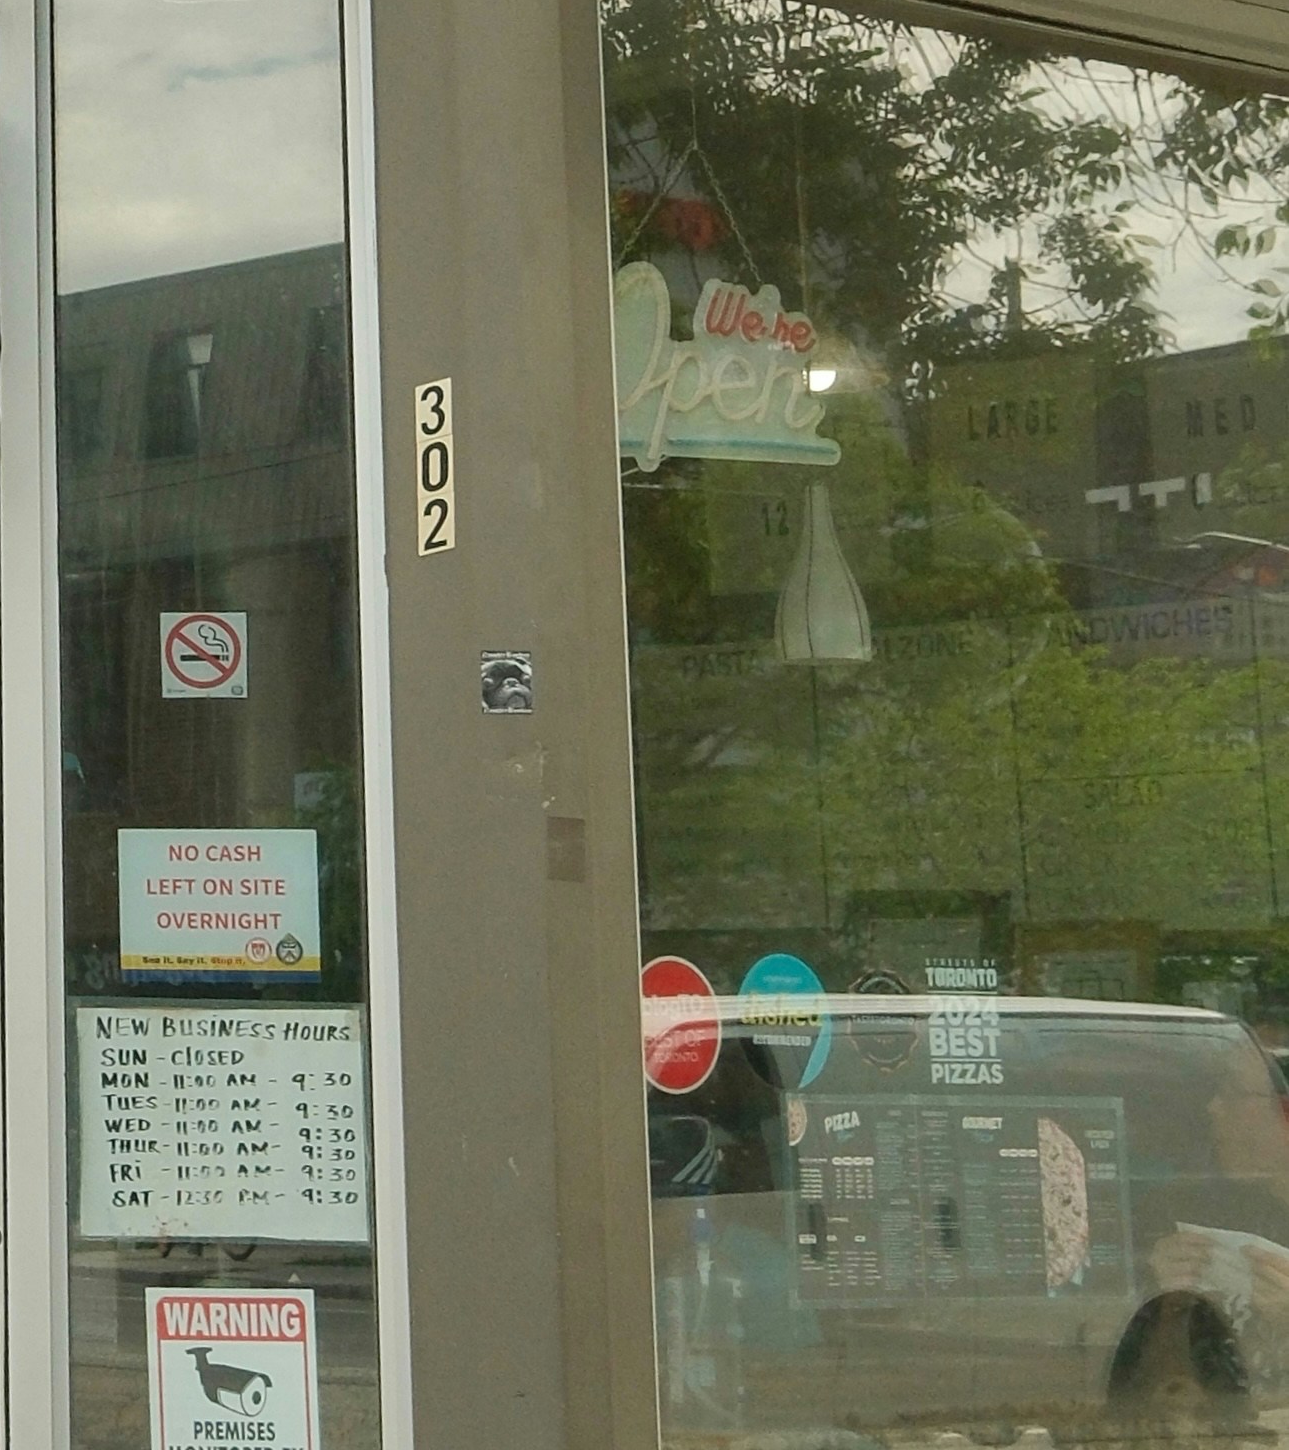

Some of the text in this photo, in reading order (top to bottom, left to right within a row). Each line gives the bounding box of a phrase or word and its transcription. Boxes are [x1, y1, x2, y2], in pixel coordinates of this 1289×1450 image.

[420, 384, 450, 552] 302
[169, 844, 261, 862] NO CASH
[146, 878, 286, 896] LEFT ON SITE
[157, 912, 281, 930] OVERNIGHT
[925, 966, 998, 988] TORONTO
[927, 996, 1000, 1027] 2024
[96, 1015, 150, 1039] NEW
[283, 1022, 351, 1041] HOURS
[928, 1027, 1002, 1058] BEST
[101, 1048, 148, 1066] SUN
[101, 1072, 150, 1089] MON
[226, 1073, 257, 1087] AM
[931, 1063, 1005, 1085] PIZZAS
[102, 1094, 158, 1111] TUES
[231, 1098, 261, 1112] AM
[105, 1118, 151, 1133] WED
[232, 1120, 262, 1134] AM
[824, 1110, 861, 1134] PIZZA
[107, 1138, 161, 1154] THUR
[237, 1141, 269, 1156] AM
[238, 1164, 271, 1178] AM
[111, 1190, 155, 1208] SAT
[163, 1302, 303, 1339] WARNING
[193, 1421, 276, 1441] PREMISES
